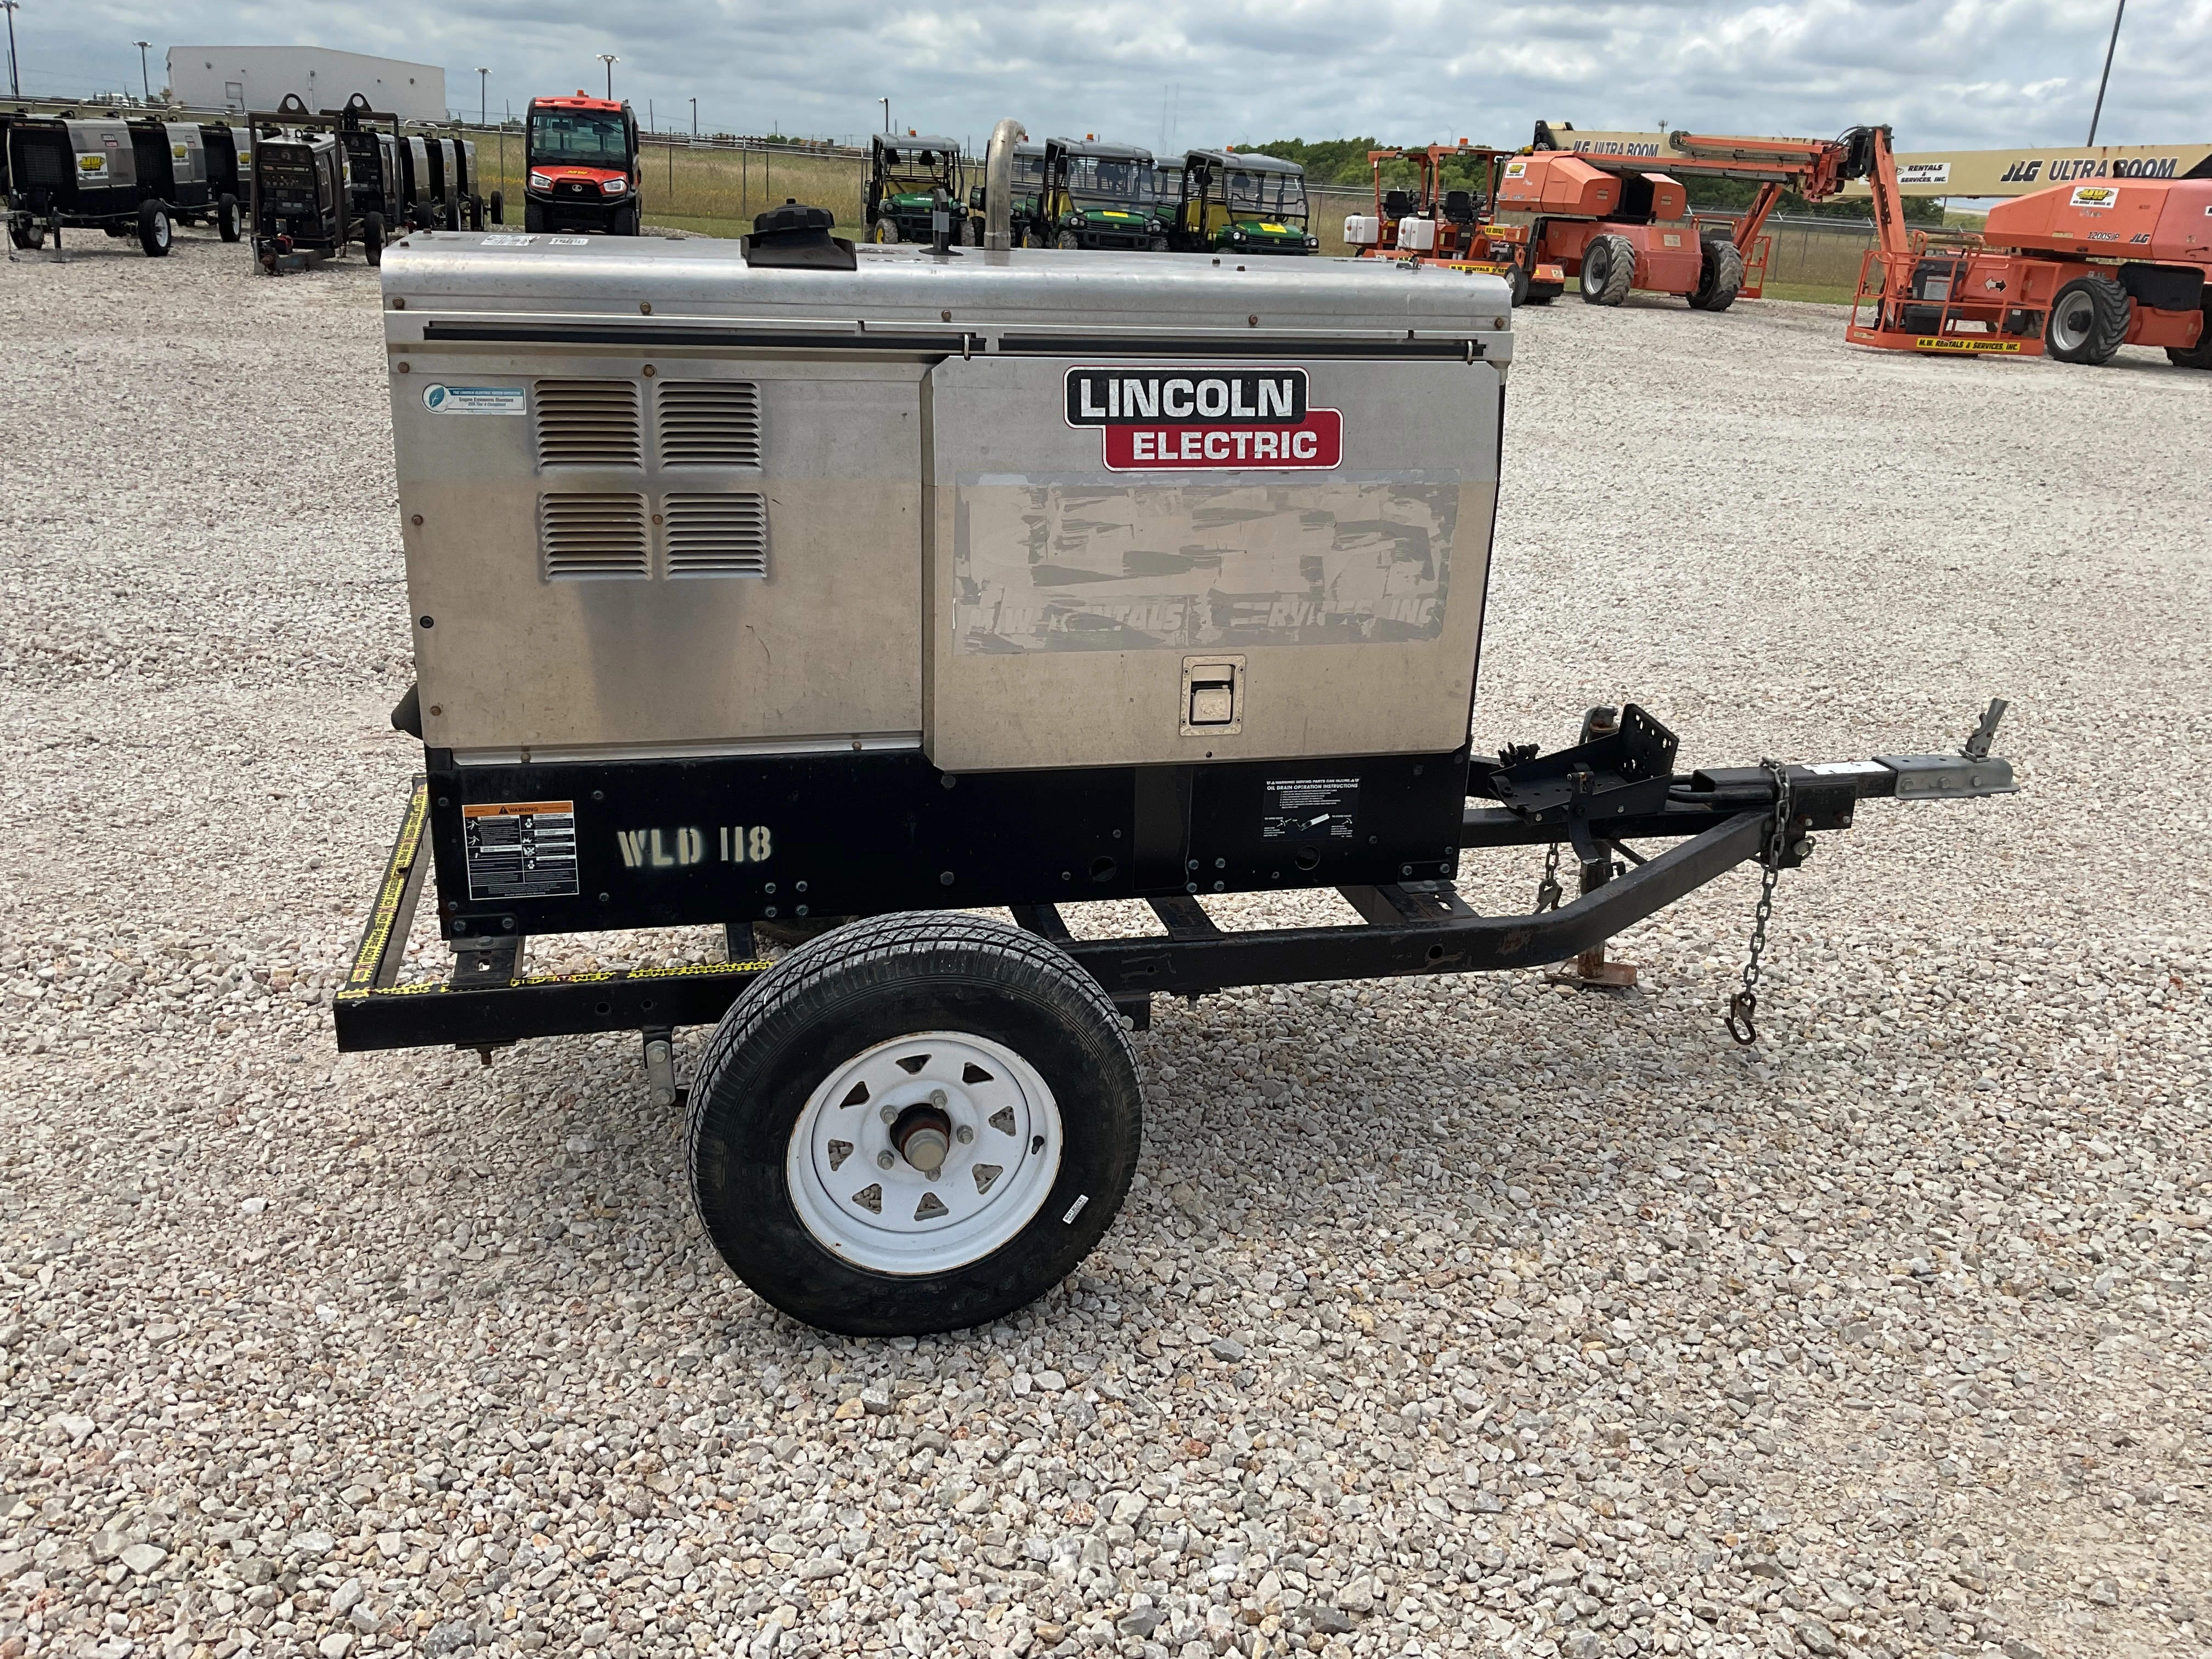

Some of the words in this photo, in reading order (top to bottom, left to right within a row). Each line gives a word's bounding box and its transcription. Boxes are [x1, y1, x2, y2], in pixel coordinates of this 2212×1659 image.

[1594, 141, 1624, 155] ULTRA
[1627, 142, 1659, 157] BOOM
[2000, 160, 2044, 182] JLG
[2048, 160, 2109, 181] ULTRA
[2087, 231, 2120, 241] 1200SJP
[2129, 234, 2151, 244] JLG
[1935, 340, 1963, 348] RENTALS
[1080, 378, 1293, 417] LINCOLN
[1132, 431, 1318, 460] ELECTRIC
[617, 826, 701, 867] WLD
[720, 826, 771, 862] 118
[388, 877, 399, 898] DEBOUT
[376, 921, 387, 930] SE
[380, 913, 389, 922] NO
[368, 930, 383, 946] PARE
[634, 968, 683, 976] TENEZ
[686, 964, 748, 973] DEBOUT
